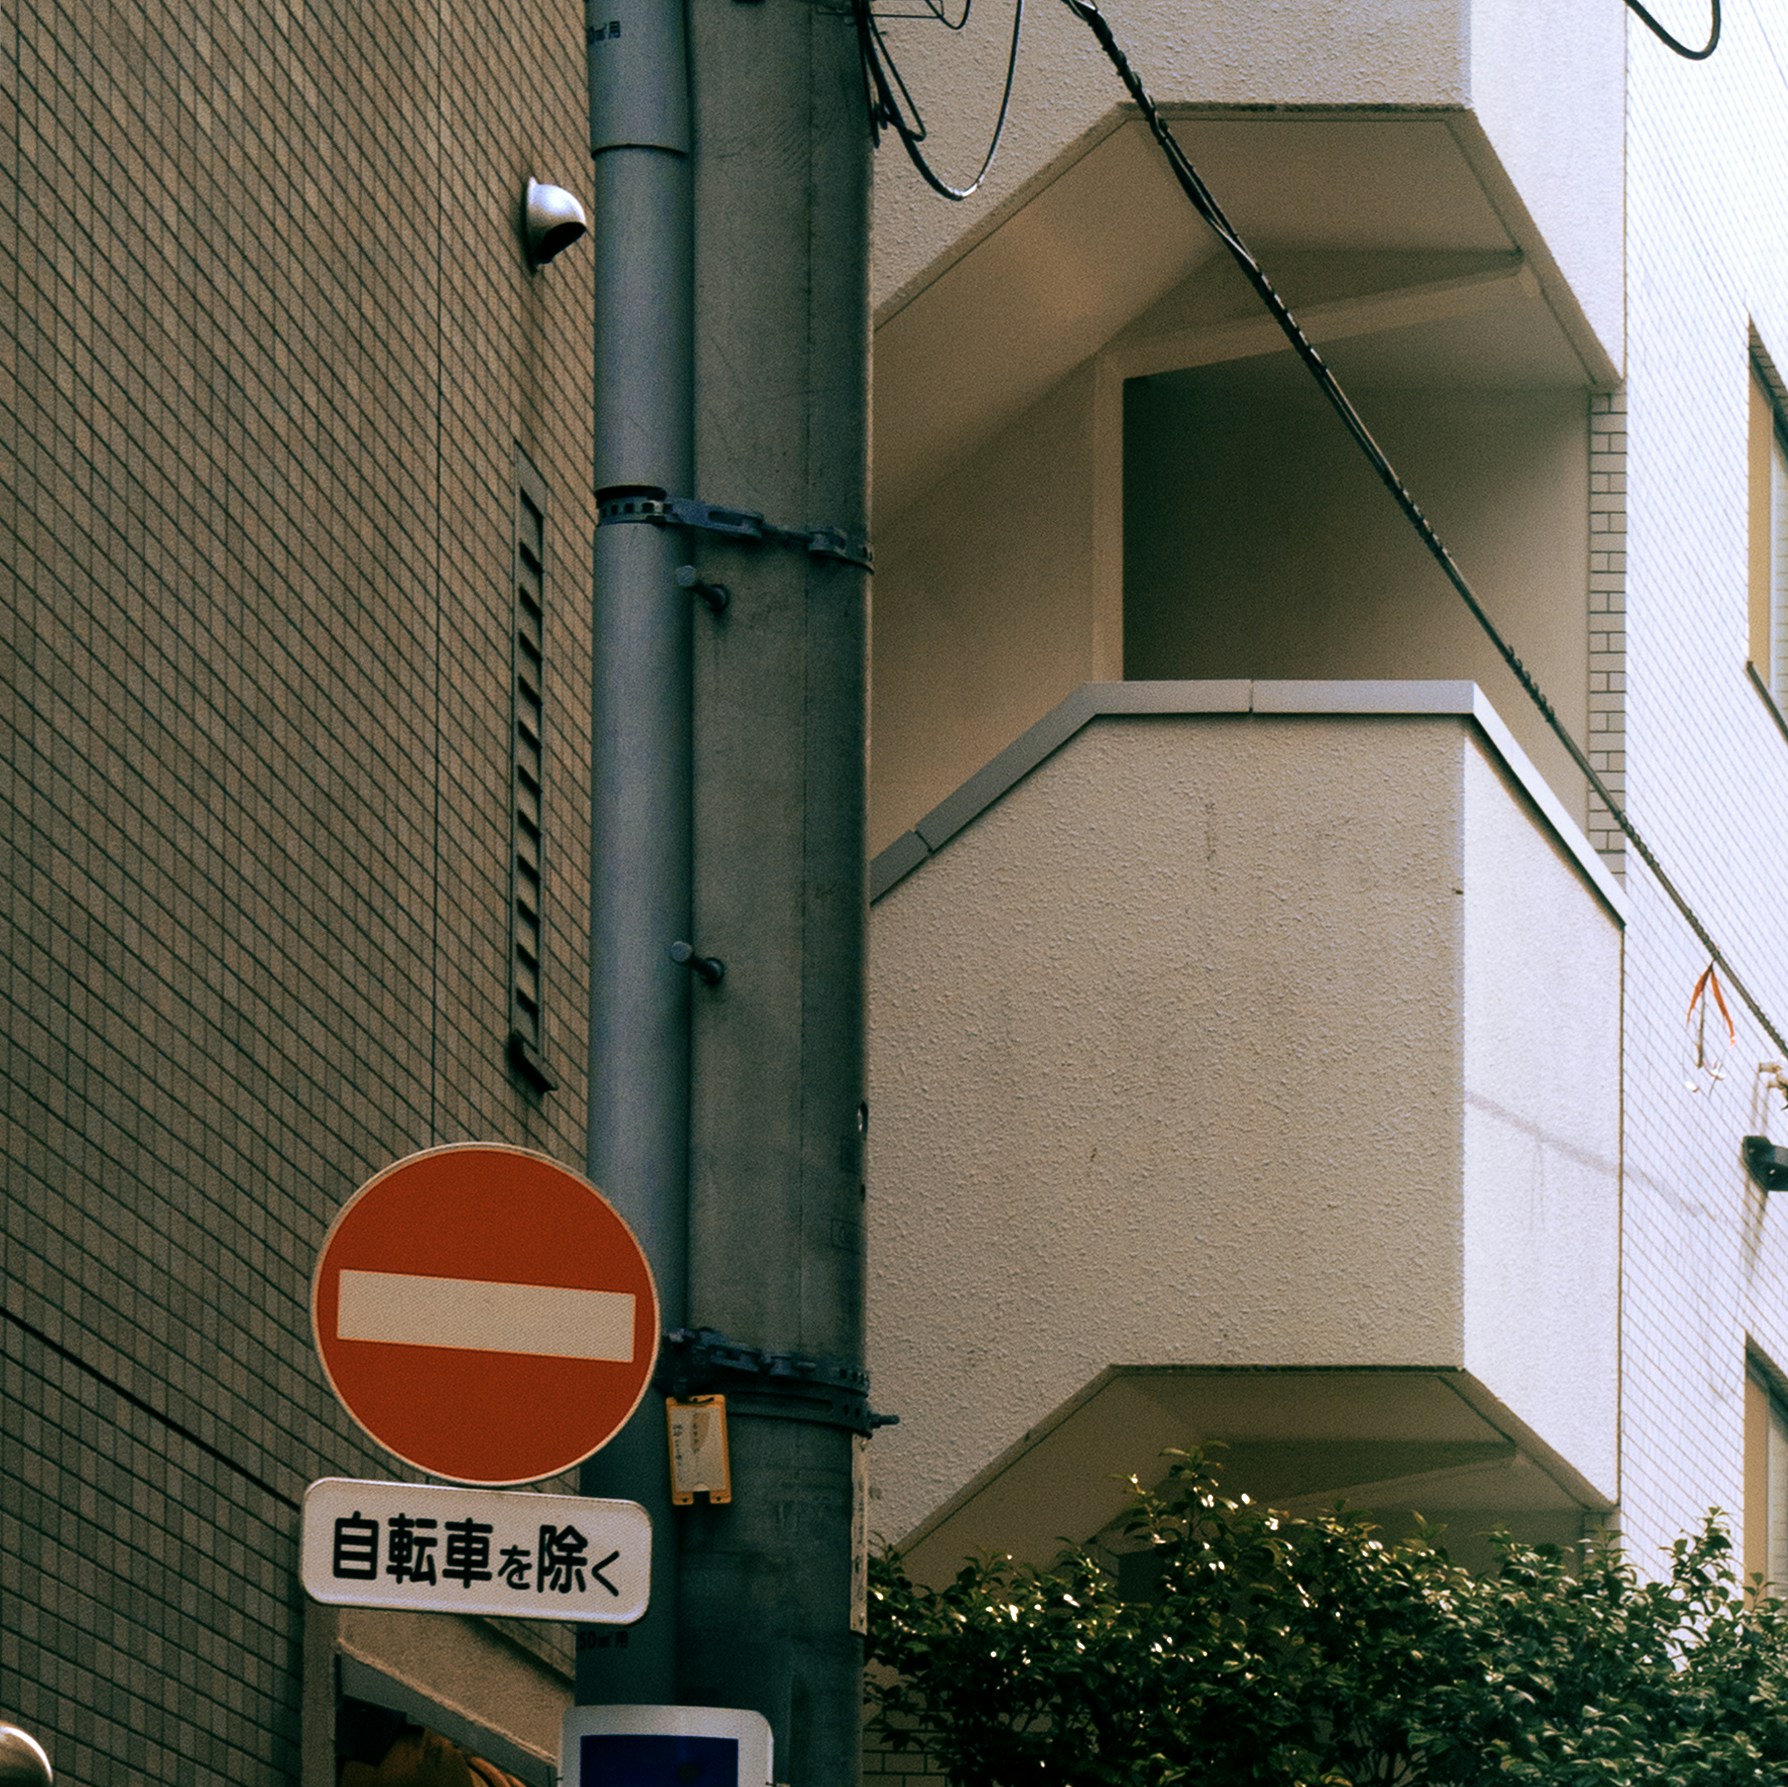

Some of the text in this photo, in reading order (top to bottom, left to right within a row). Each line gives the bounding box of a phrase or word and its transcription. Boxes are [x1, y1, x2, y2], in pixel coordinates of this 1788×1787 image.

[332, 1511, 621, 1598] 自転車を除く
